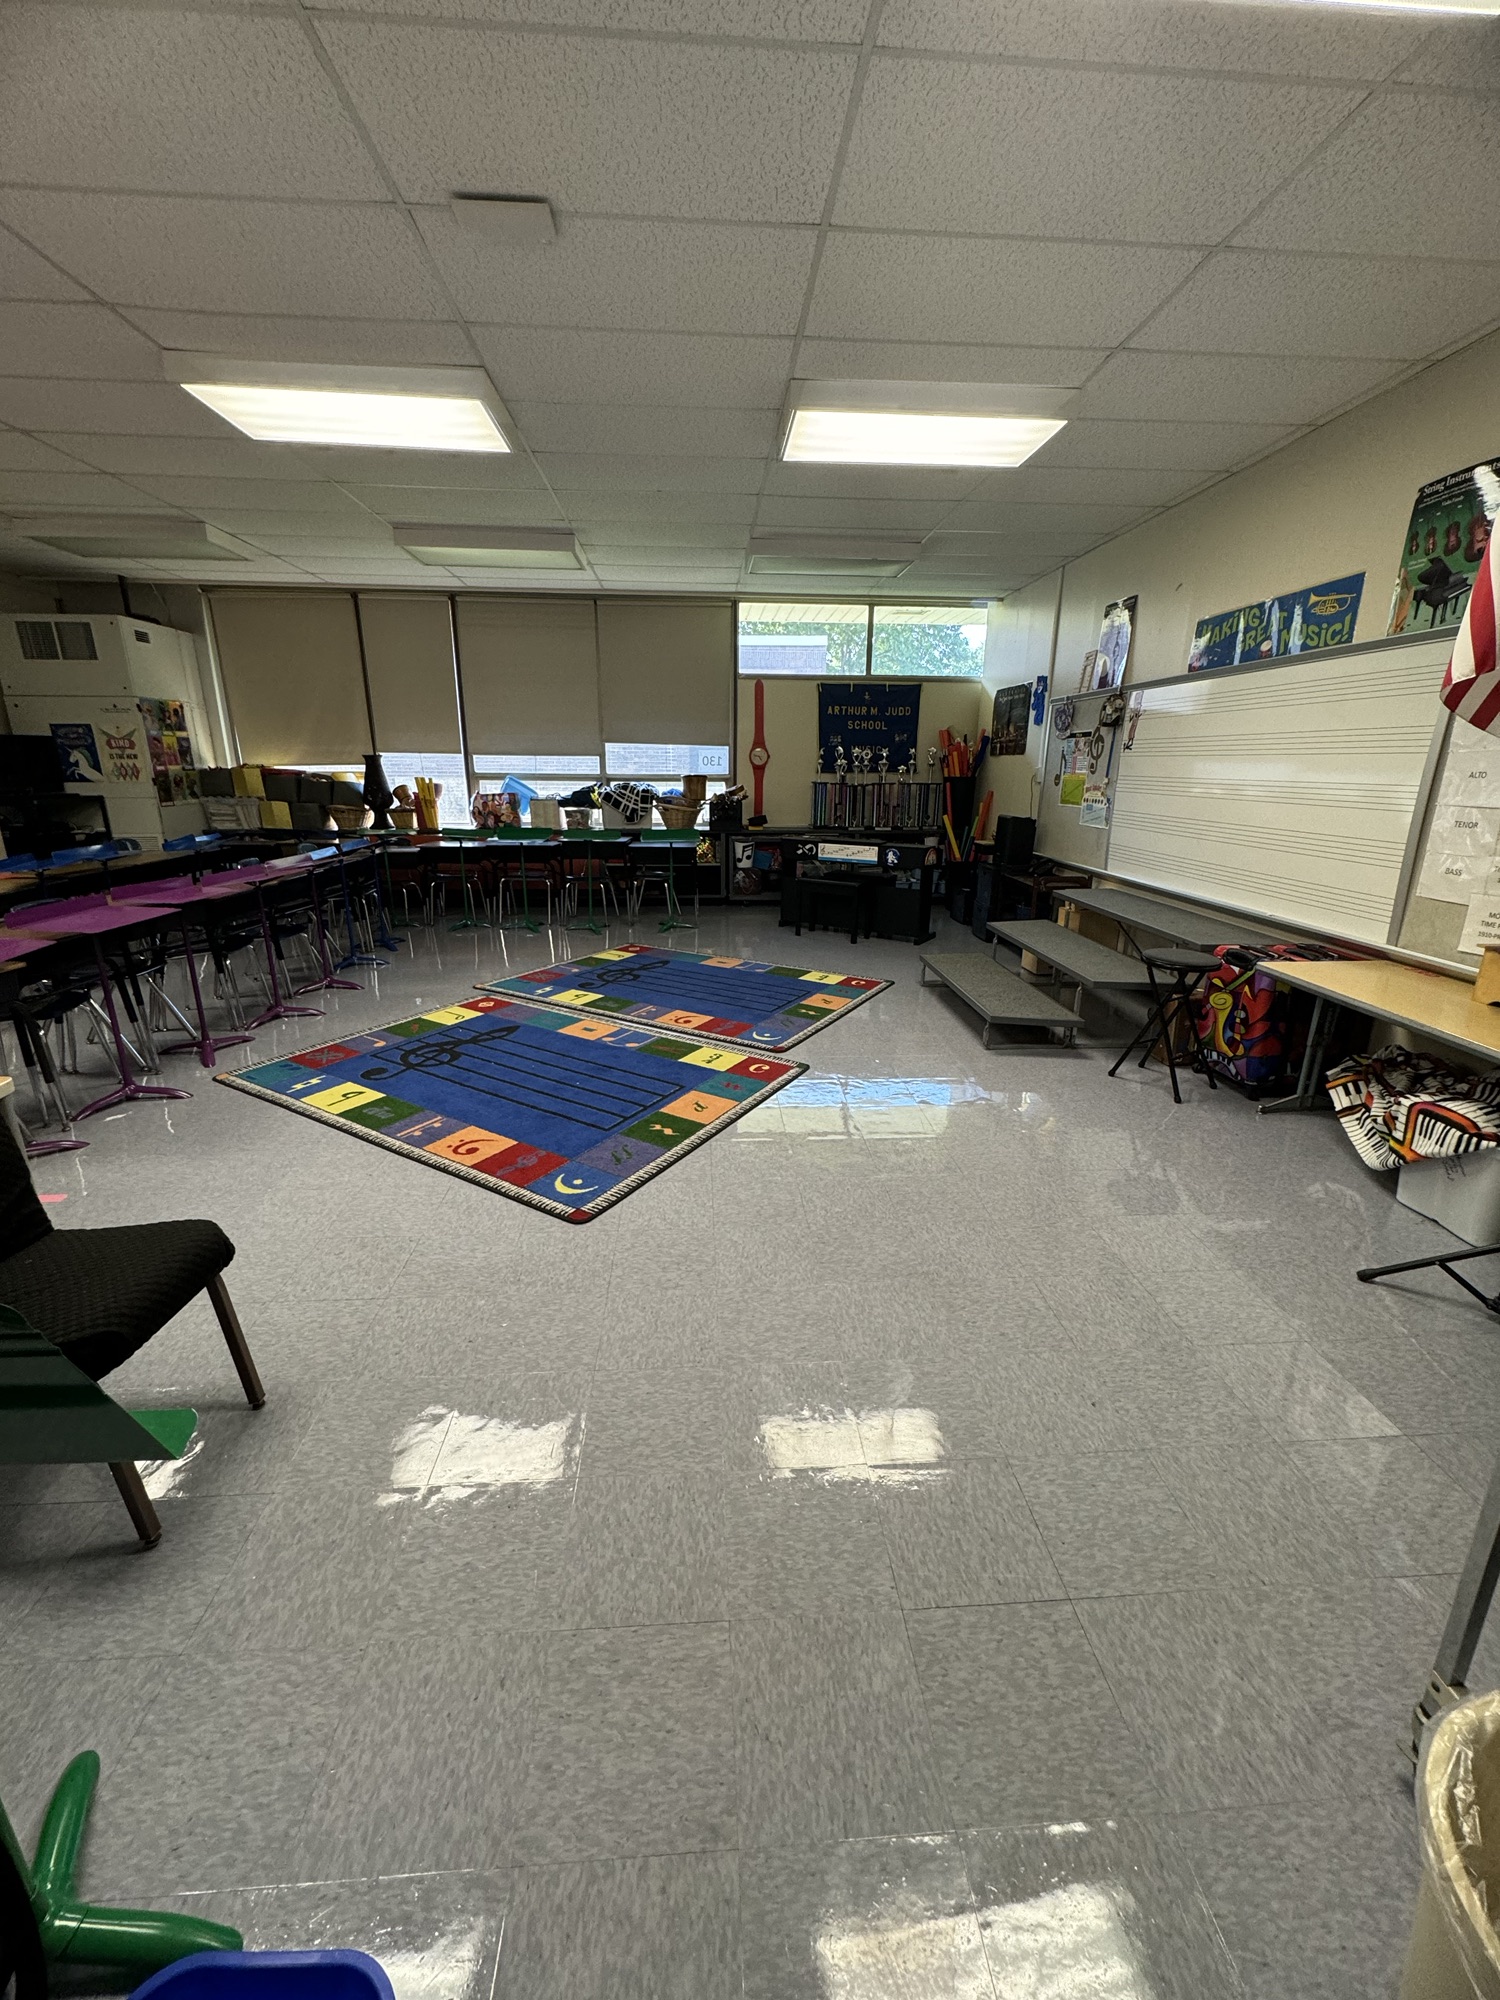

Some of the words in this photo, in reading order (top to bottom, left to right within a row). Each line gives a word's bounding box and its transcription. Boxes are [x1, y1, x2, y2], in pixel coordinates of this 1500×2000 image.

[1423, 481, 1446, 496] String
[827, 705, 868, 716] ARTHUR
[870, 706, 881, 716] M.
[884, 706, 911, 716] JUDD
[847, 720, 888, 730] SCHOOL
[110, 738, 130, 748] KIND
[1468, 771, 1487, 779] ALTO
[1454, 820, 1479, 829] TENOR
[1444, 867, 1462, 876] BASS
[1481, 920, 1497, 929] TIME
